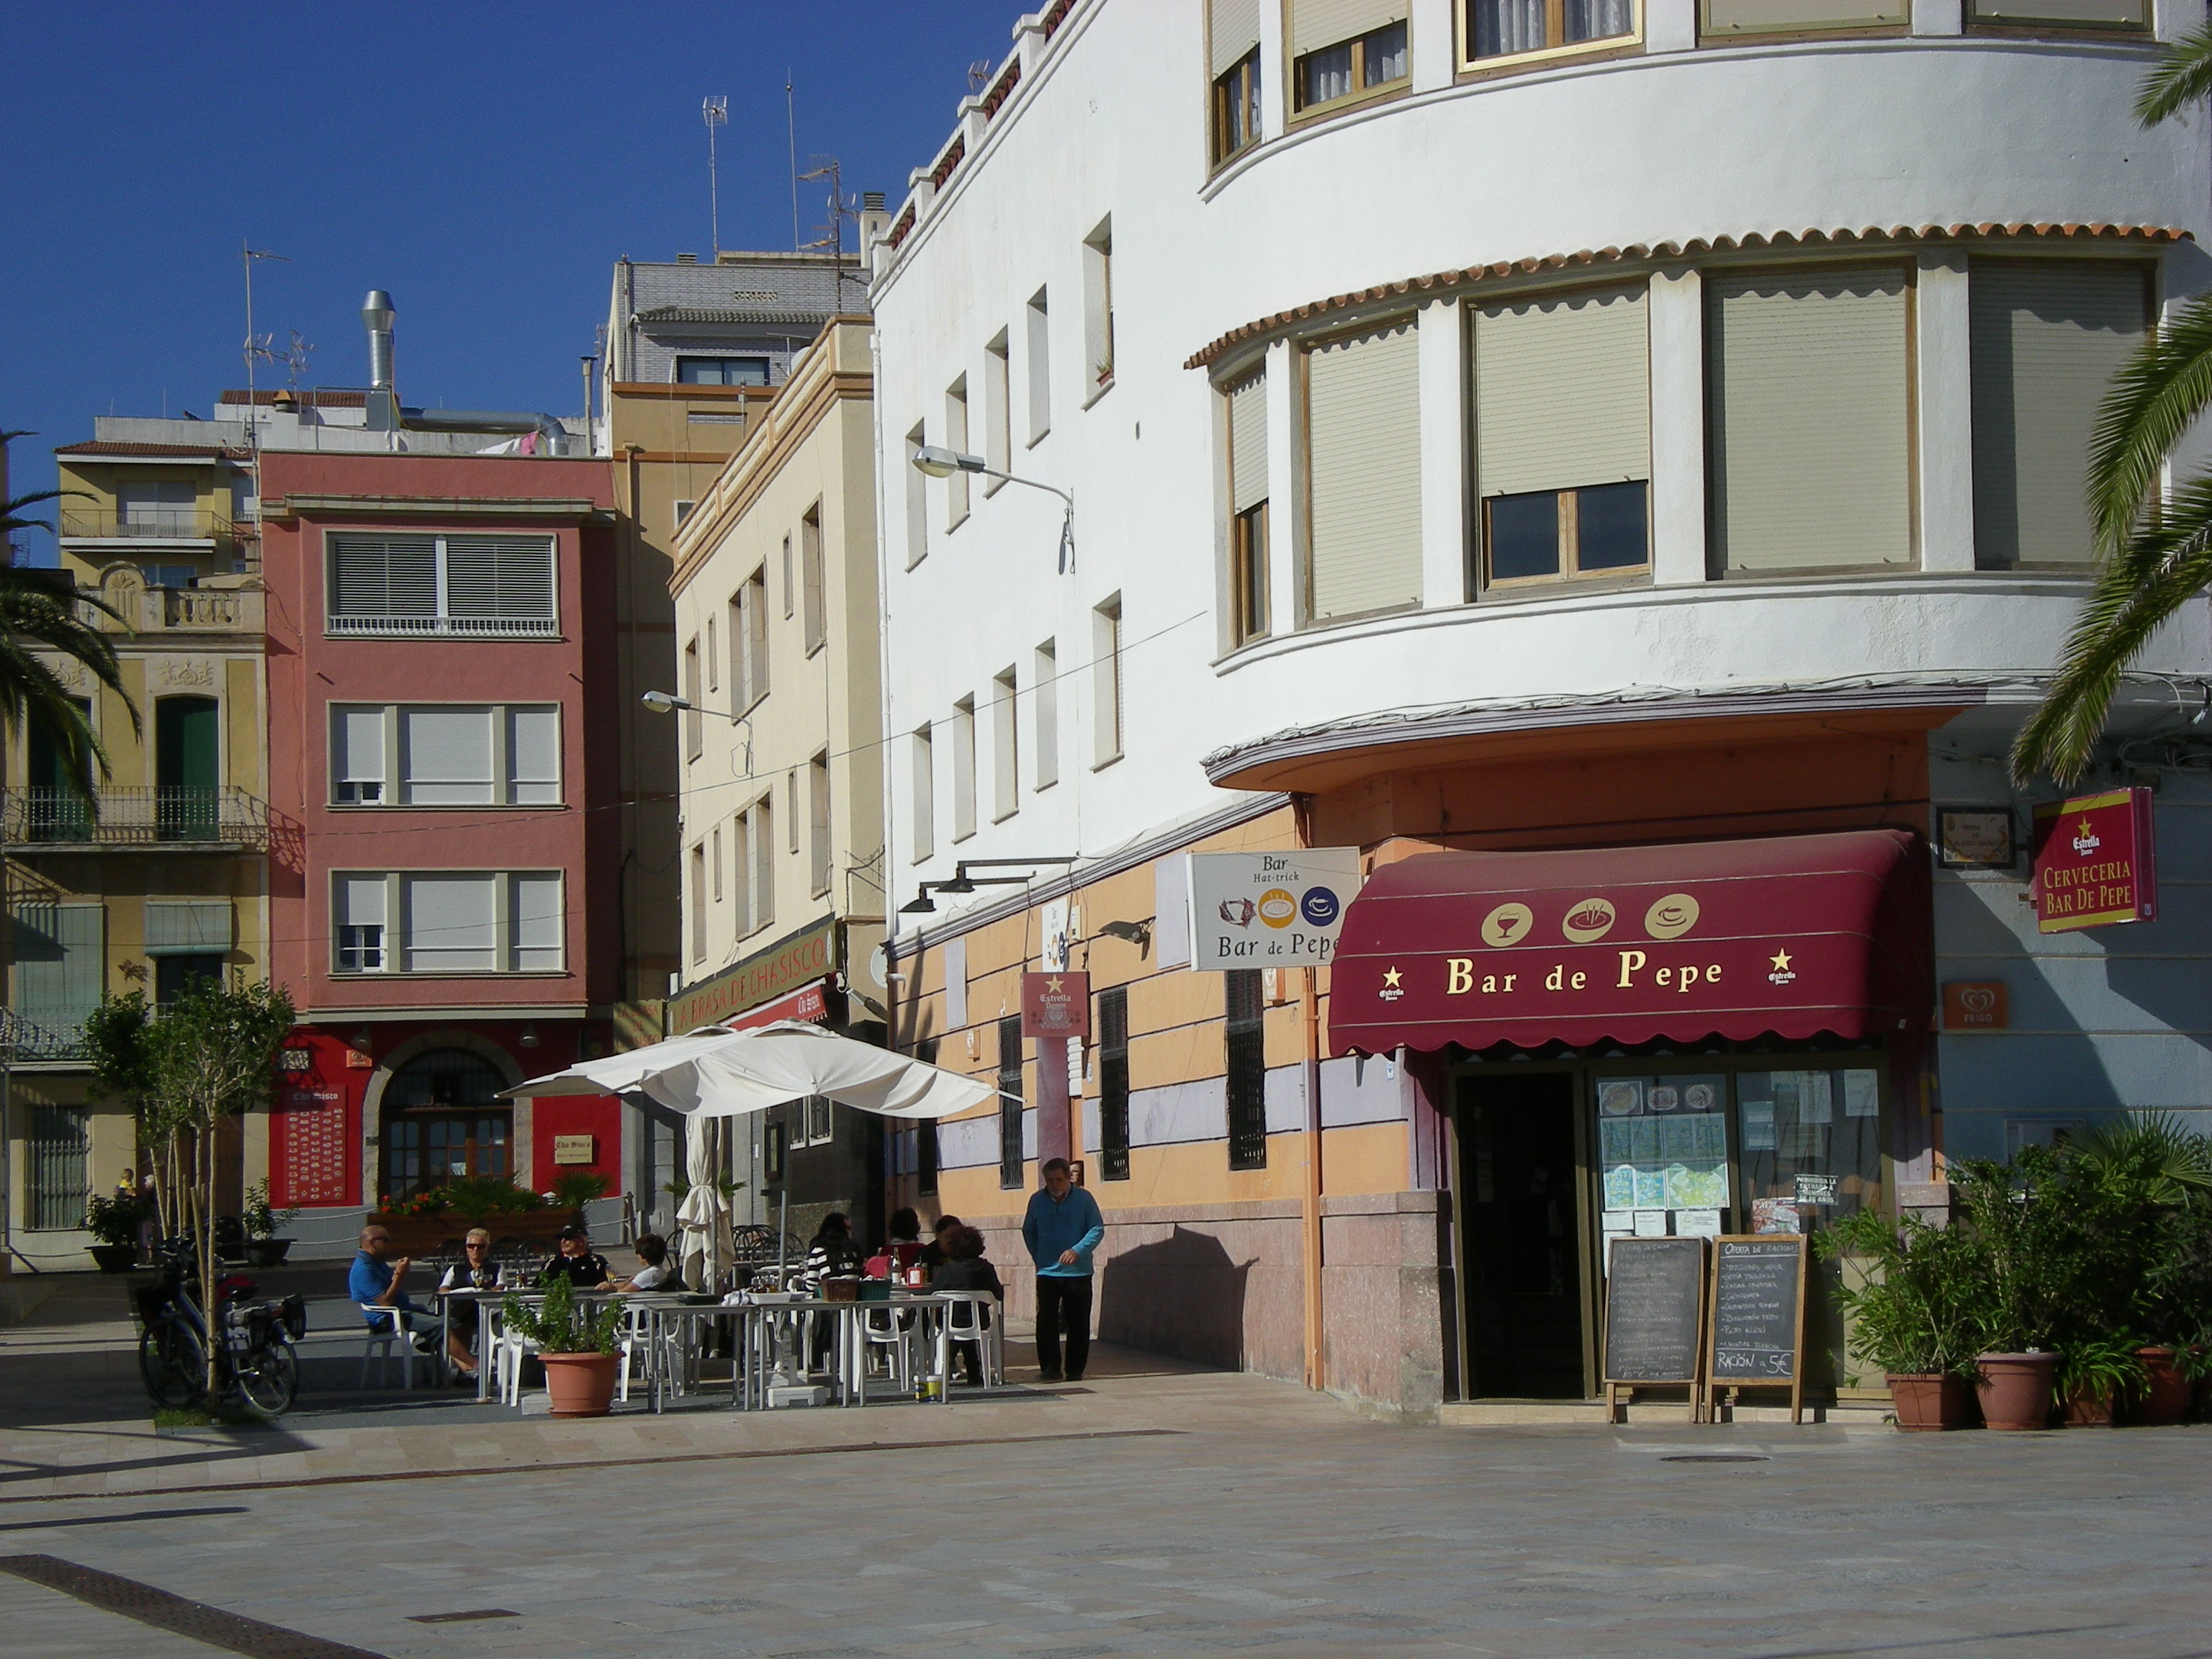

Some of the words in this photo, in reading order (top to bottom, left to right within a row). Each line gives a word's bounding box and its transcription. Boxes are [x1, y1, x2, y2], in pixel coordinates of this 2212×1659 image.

[2073, 835, 2100, 850] Estrella
[1264, 855, 1288, 871] Bar
[1253, 871, 1299, 883] Hat-trick
[2044, 860, 2131, 889] CERVECERIA
[1218, 936, 1259, 957] Bar
[1268, 941, 1283, 955] de
[1446, 958, 1517, 994] Bar
[1545, 964, 1587, 991] de
[1616, 950, 1722, 993] Pepe
[673, 1005, 687, 1030] LA
[692, 988, 727, 1024] BRASA
[732, 976, 746, 1005] DE
[1039, 994, 1071, 1002] Estrella
[1964, 1014, 1993, 1022] FRIGO
[1725, 1243, 1750, 1254] OFERTA
